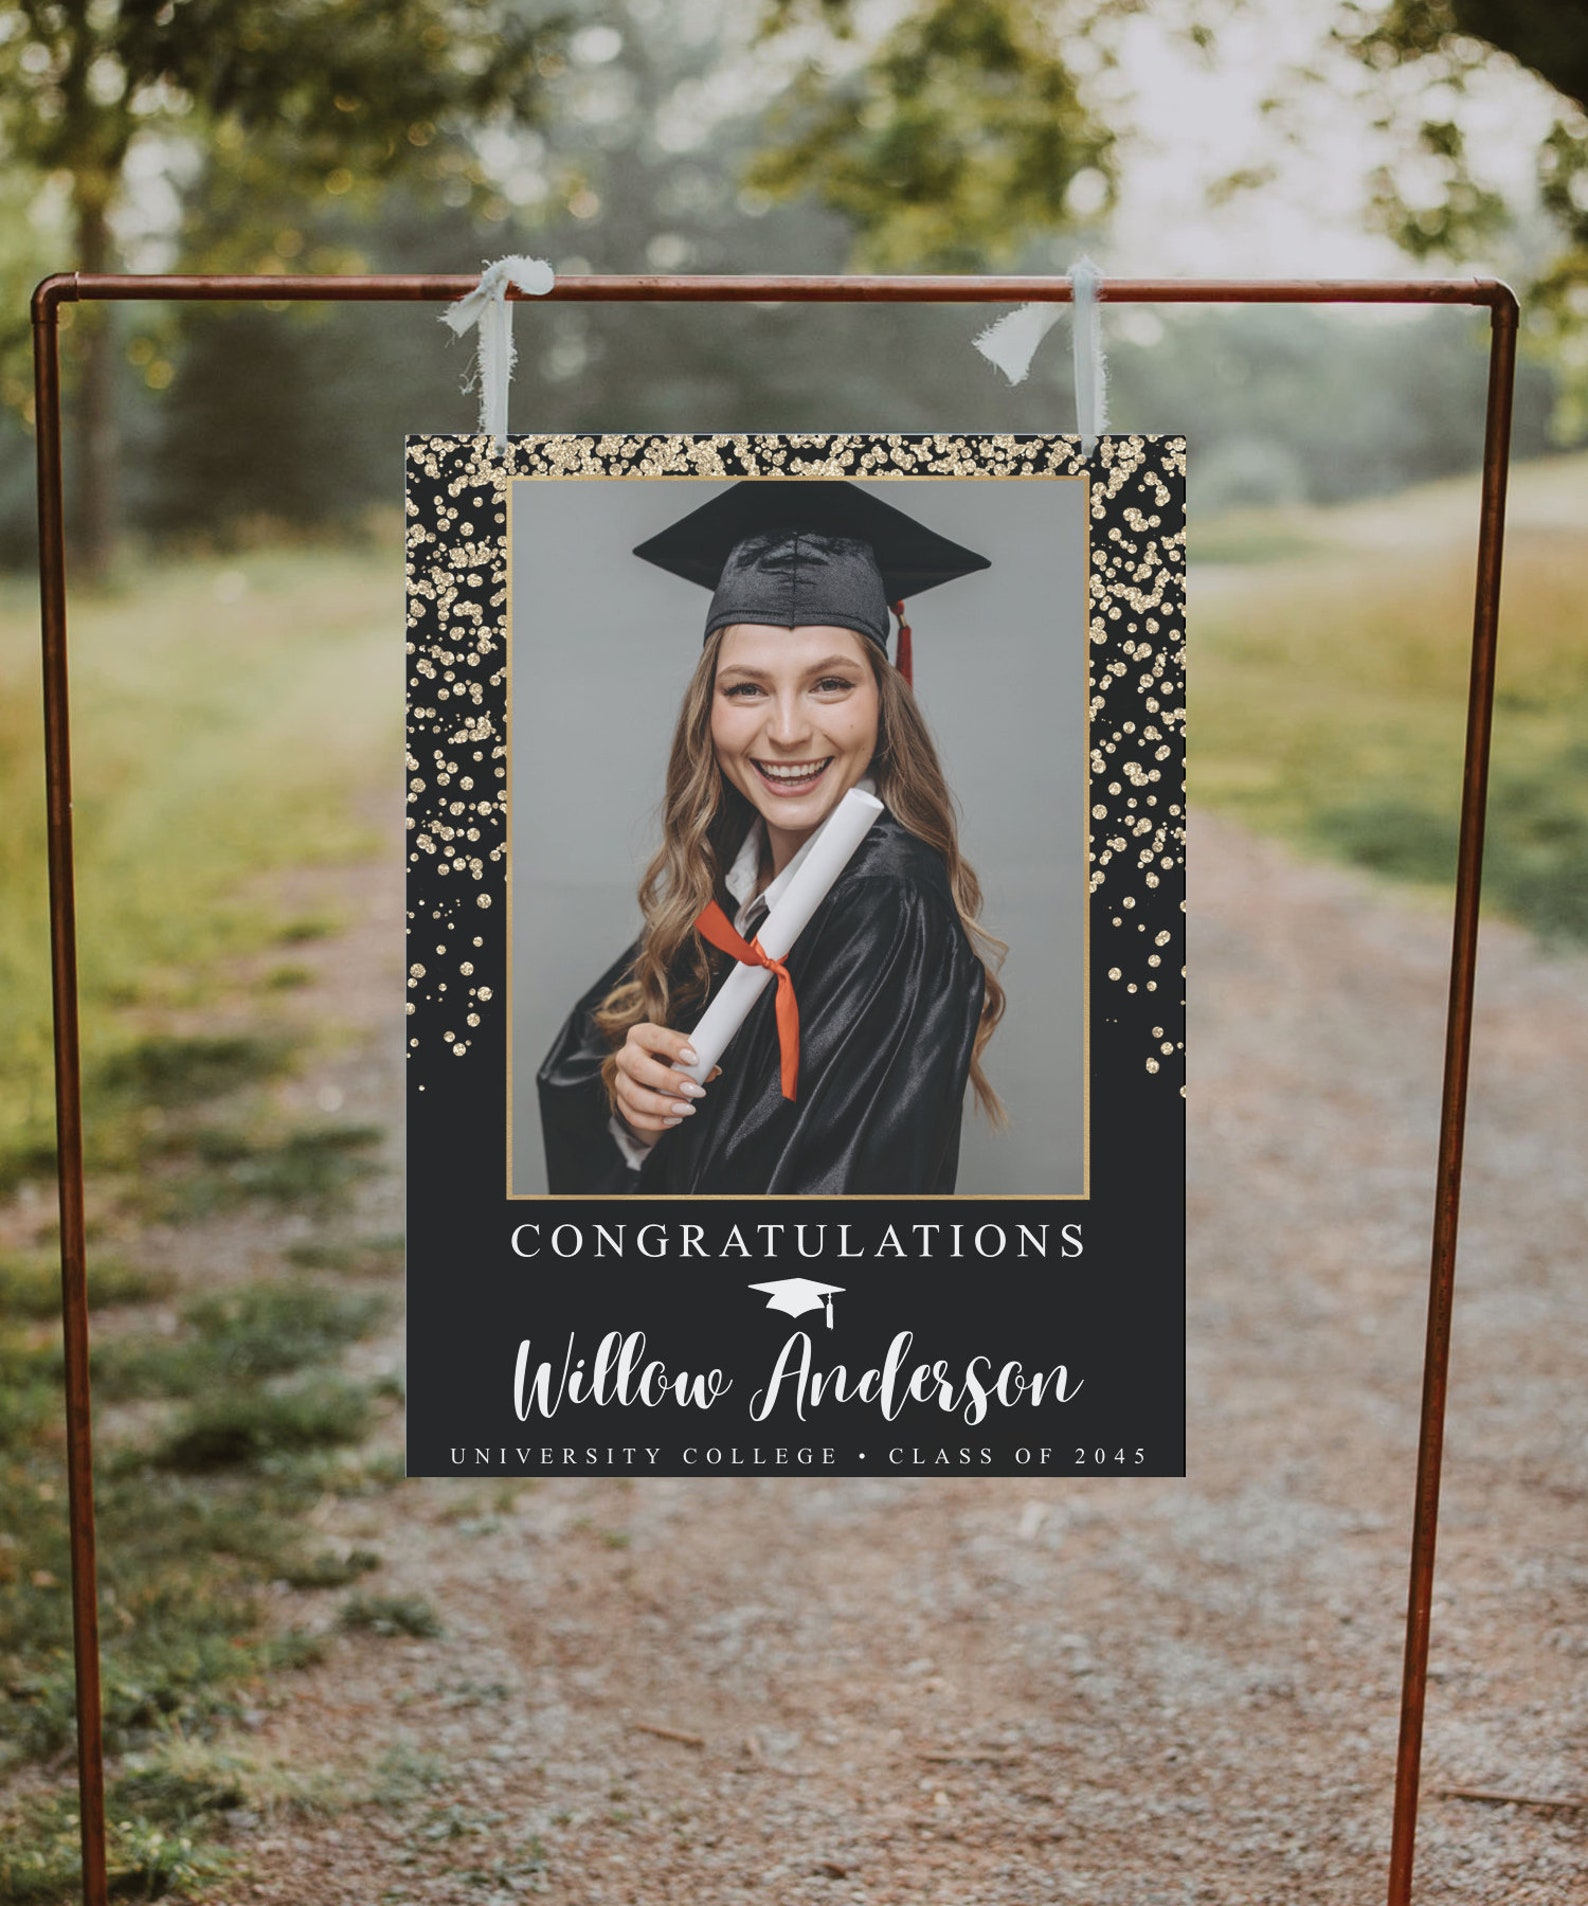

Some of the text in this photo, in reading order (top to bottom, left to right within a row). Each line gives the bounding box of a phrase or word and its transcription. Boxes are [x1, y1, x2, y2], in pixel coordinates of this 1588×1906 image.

[510, 1223, 1084, 1258] CONGRATULATIONS
[513, 1330, 1084, 1426] Willow Anderson
[450, 1447, 1147, 1465] UNIVERSITY COLLEGE CLASS OF 2045
